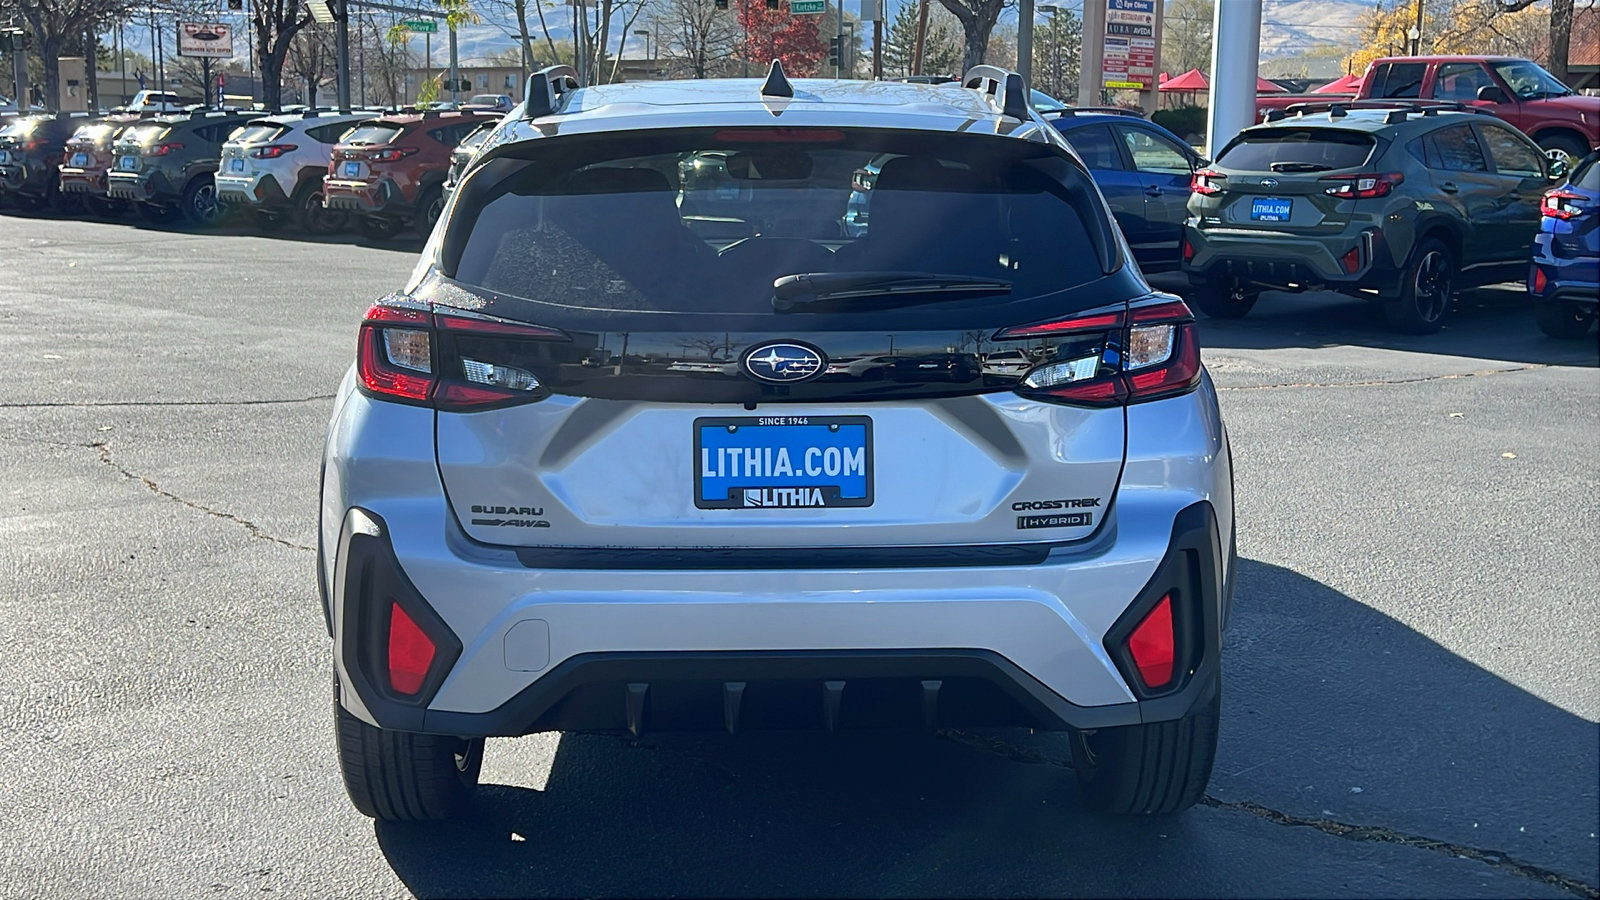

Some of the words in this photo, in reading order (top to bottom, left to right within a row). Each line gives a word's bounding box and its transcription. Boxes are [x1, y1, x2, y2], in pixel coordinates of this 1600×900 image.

[1124, 0, 1133, 8] Eye
[1108, 24, 1130, 34] AURA
[1133, 27, 1151, 36] AVEDA
[1252, 204, 1290, 215] LITHIA.COM
[758, 417, 786, 426] SINCE
[787, 416, 809, 425] 1946
[701, 446, 866, 478] LITHIA.COM
[762, 487, 825, 507] LITHIA
[1011, 497, 1101, 512] CROSSTREK
[471, 505, 544, 516] SUBARU
[500, 519, 551, 528] AWD
[1029, 516, 1081, 526] HYBRID
